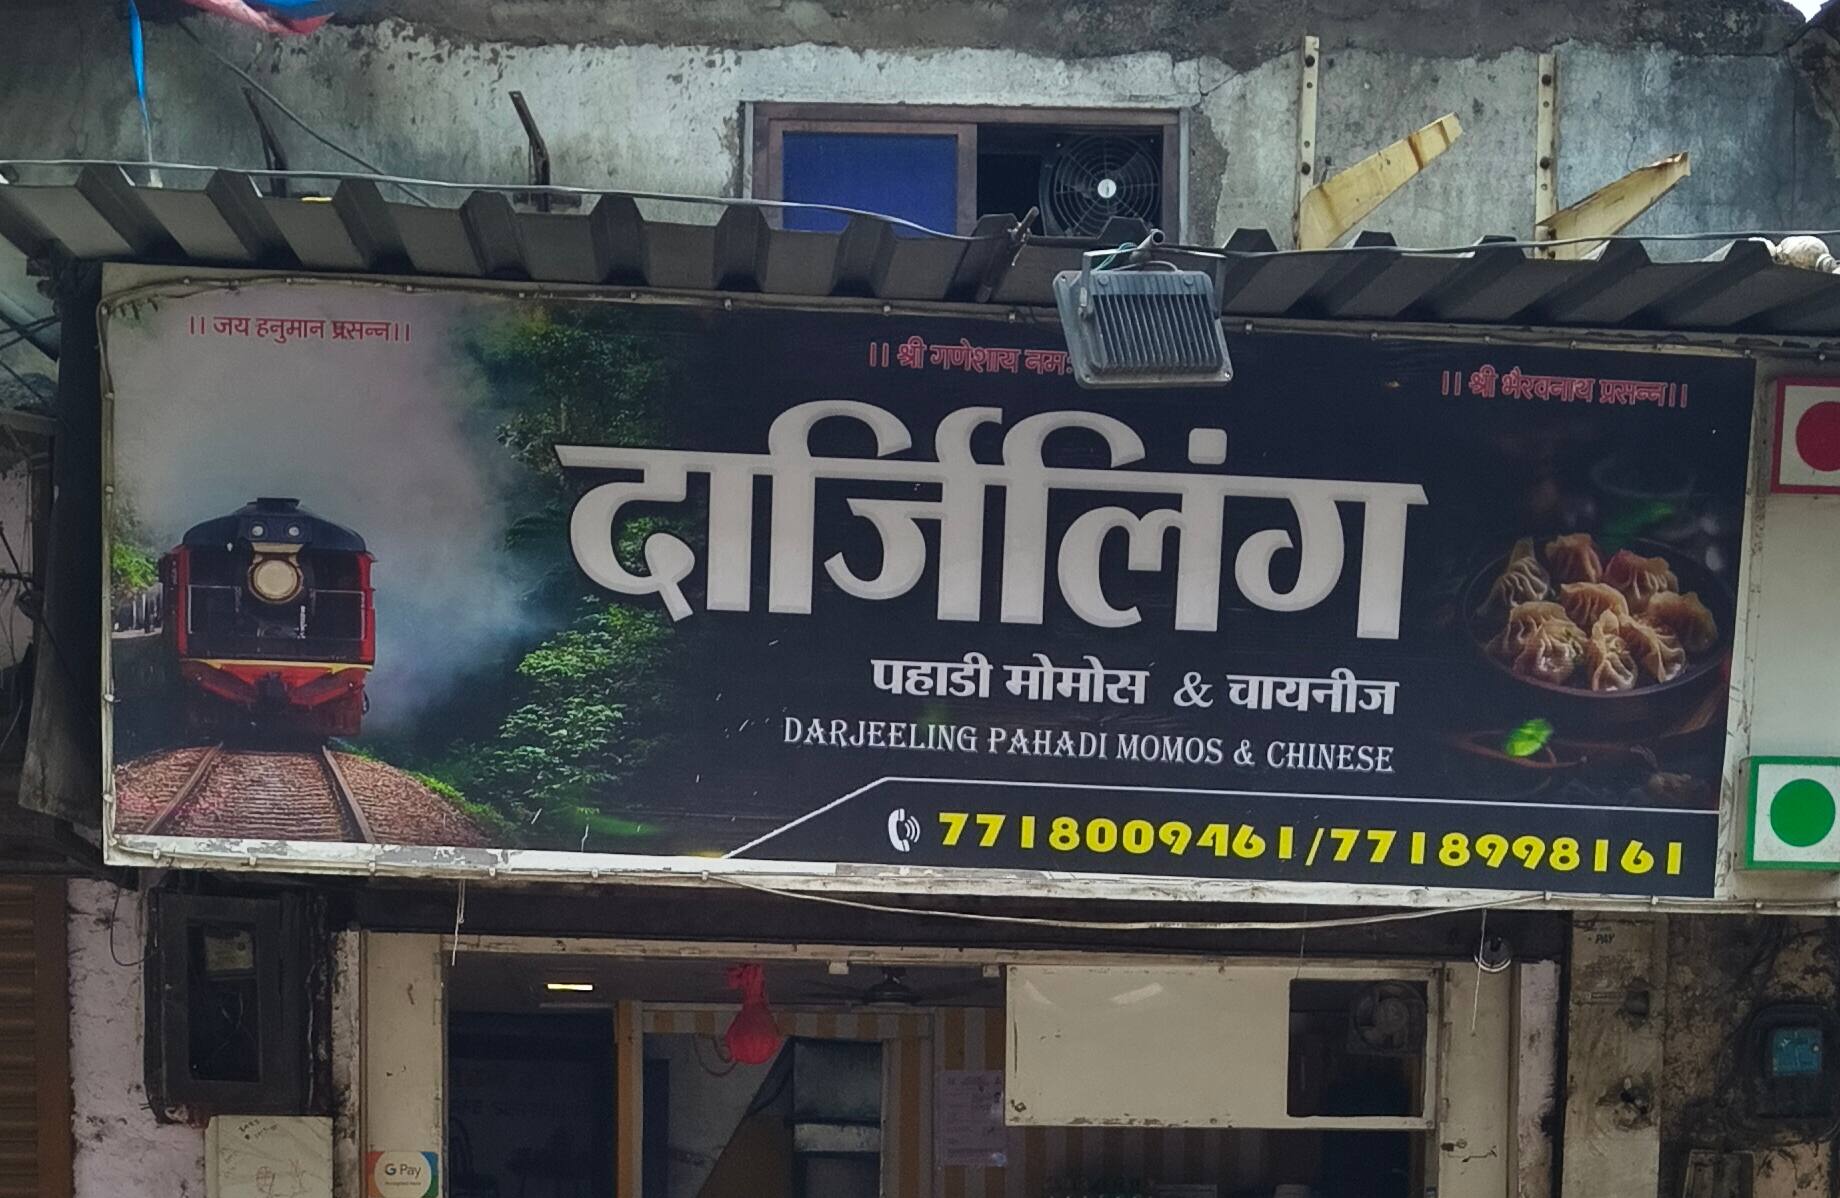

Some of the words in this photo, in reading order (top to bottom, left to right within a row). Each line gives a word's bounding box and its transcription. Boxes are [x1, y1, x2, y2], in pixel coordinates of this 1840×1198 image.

[213, 316, 250, 336] जय
[256, 318, 325, 343] हनुमान
[897, 335, 927, 368] श्री
[1468, 364, 1498, 398] श्री
[555, 399, 1428, 640] दार्जिलिंग
[871, 652, 992, 699] पहाडी
[1002, 654, 1149, 704] मोमोस
[1173, 672, 1213, 708] &
[1226, 667, 1400, 714] चायनीज
[784, 716, 977, 752] DARJEELING
[987, 727, 1106, 760] PAHADI
[1117, 734, 1223, 766] MOMOS
[1234, 740, 1255, 767] &
[1267, 740, 1394, 773] CHINESE
[385, 1163, 397, 1176] G
[400, 1163, 421, 1179] Pay
